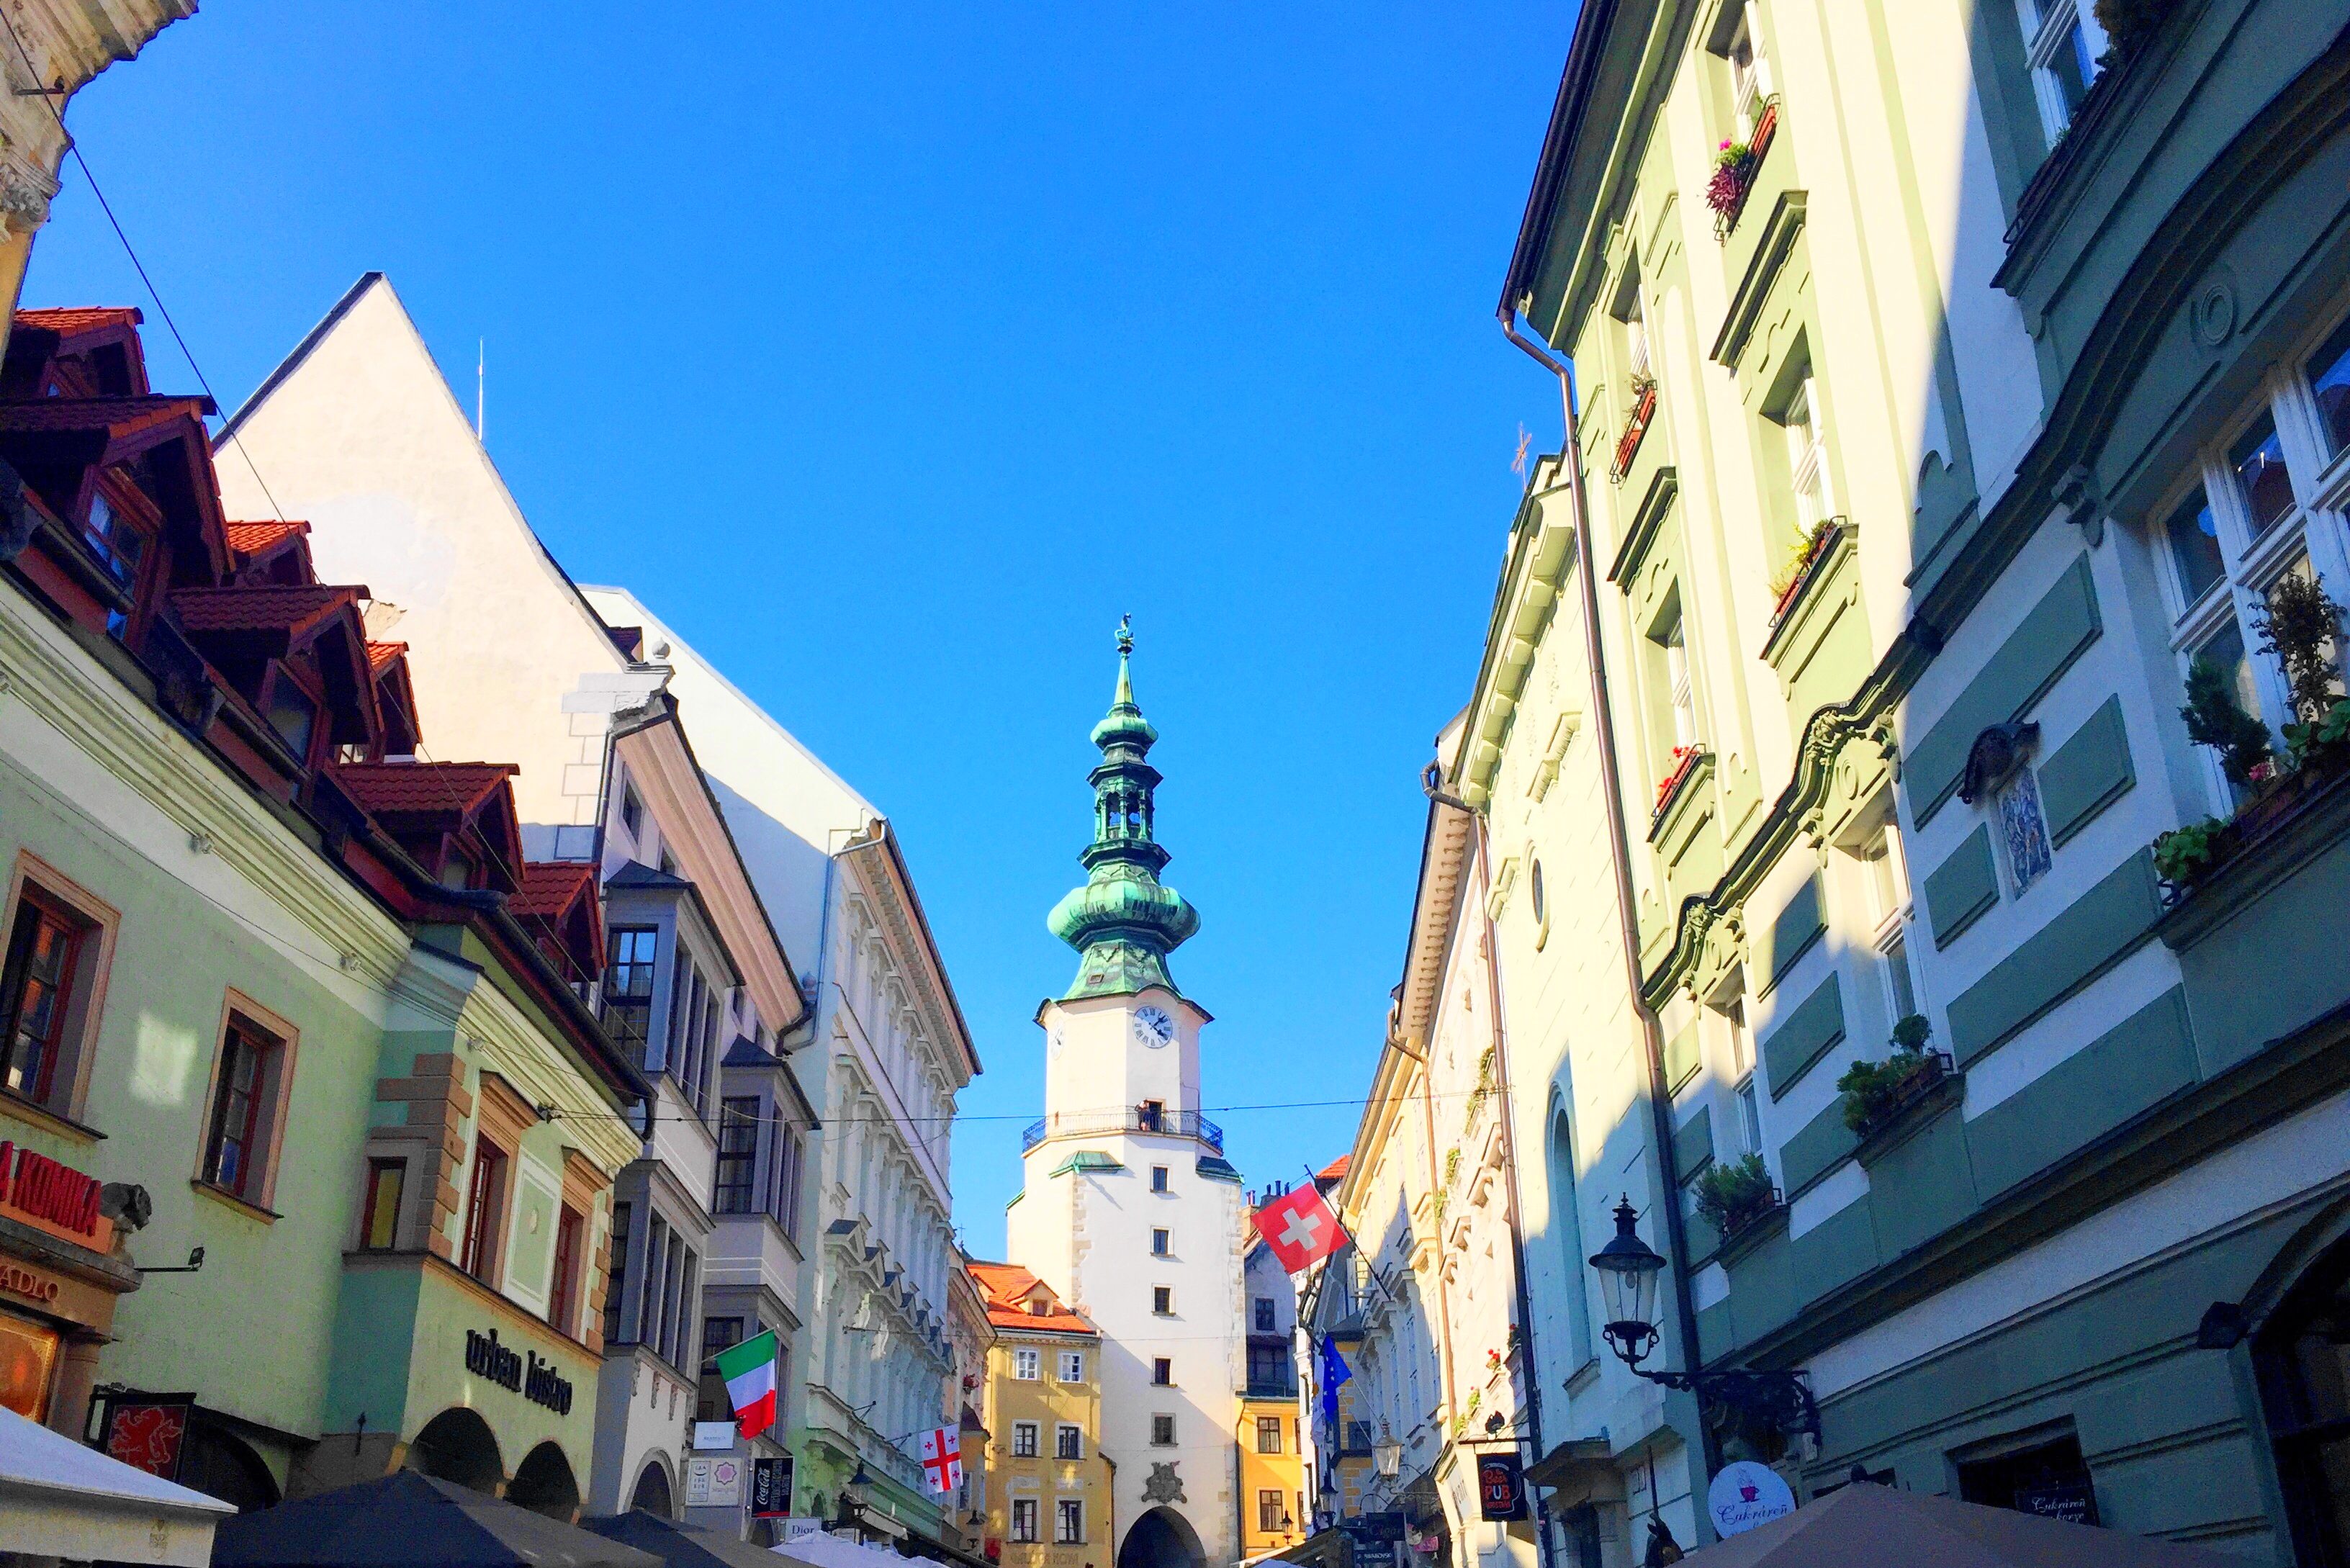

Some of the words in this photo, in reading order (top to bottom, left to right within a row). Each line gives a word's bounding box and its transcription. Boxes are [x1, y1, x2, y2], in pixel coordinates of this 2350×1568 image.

[466, 1328, 522, 1393] urban
[525, 1350, 572, 1416] bistro
[1485, 1484, 1511, 1500] PUB
[792, 1525, 815, 1534] Dior
